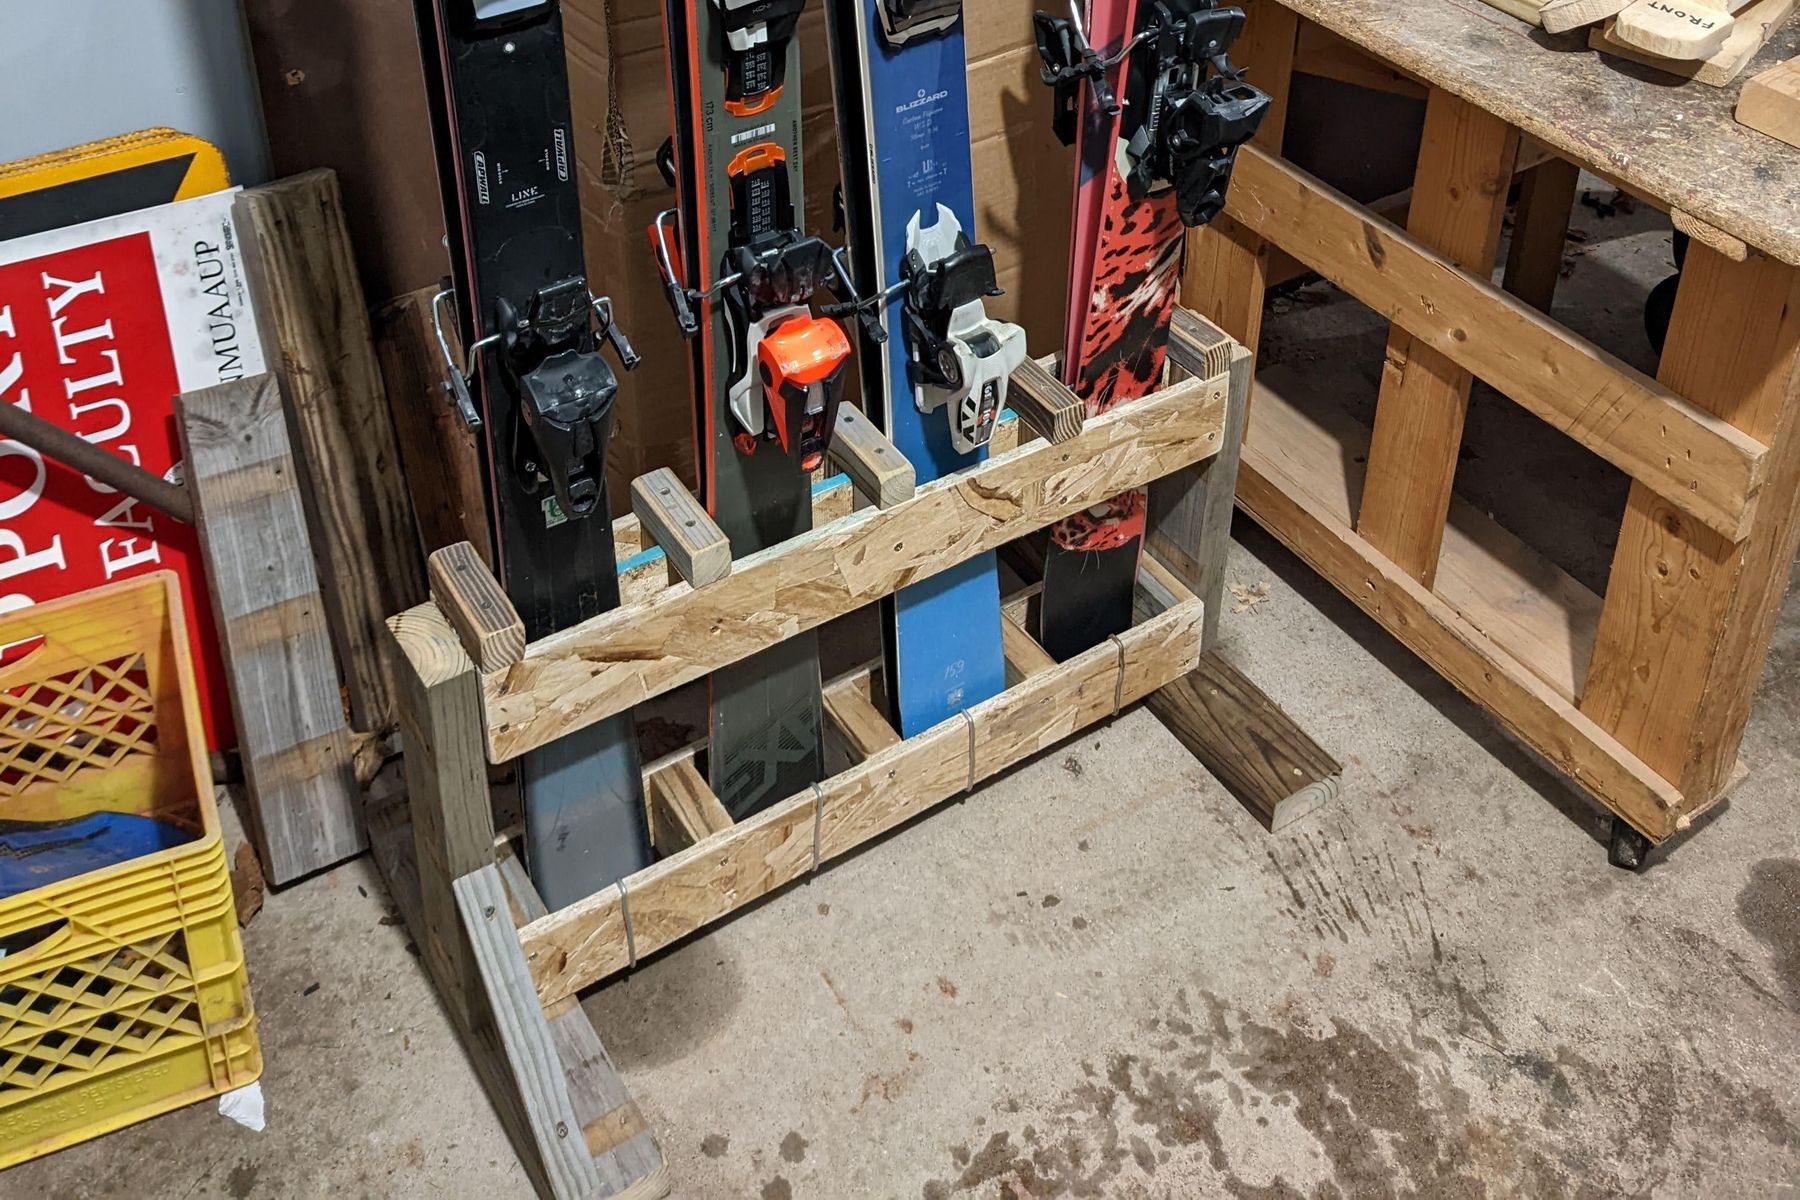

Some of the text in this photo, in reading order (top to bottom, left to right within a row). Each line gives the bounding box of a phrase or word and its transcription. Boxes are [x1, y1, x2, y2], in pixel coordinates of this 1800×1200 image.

[1648, 1, 1716, 30] FRONT
[896, 91, 948, 114] BLIZZARD
[554, 129, 568, 181] CAPWALL
[474, 151, 490, 204] CAPWALL
[512, 186, 538, 202] LINE
